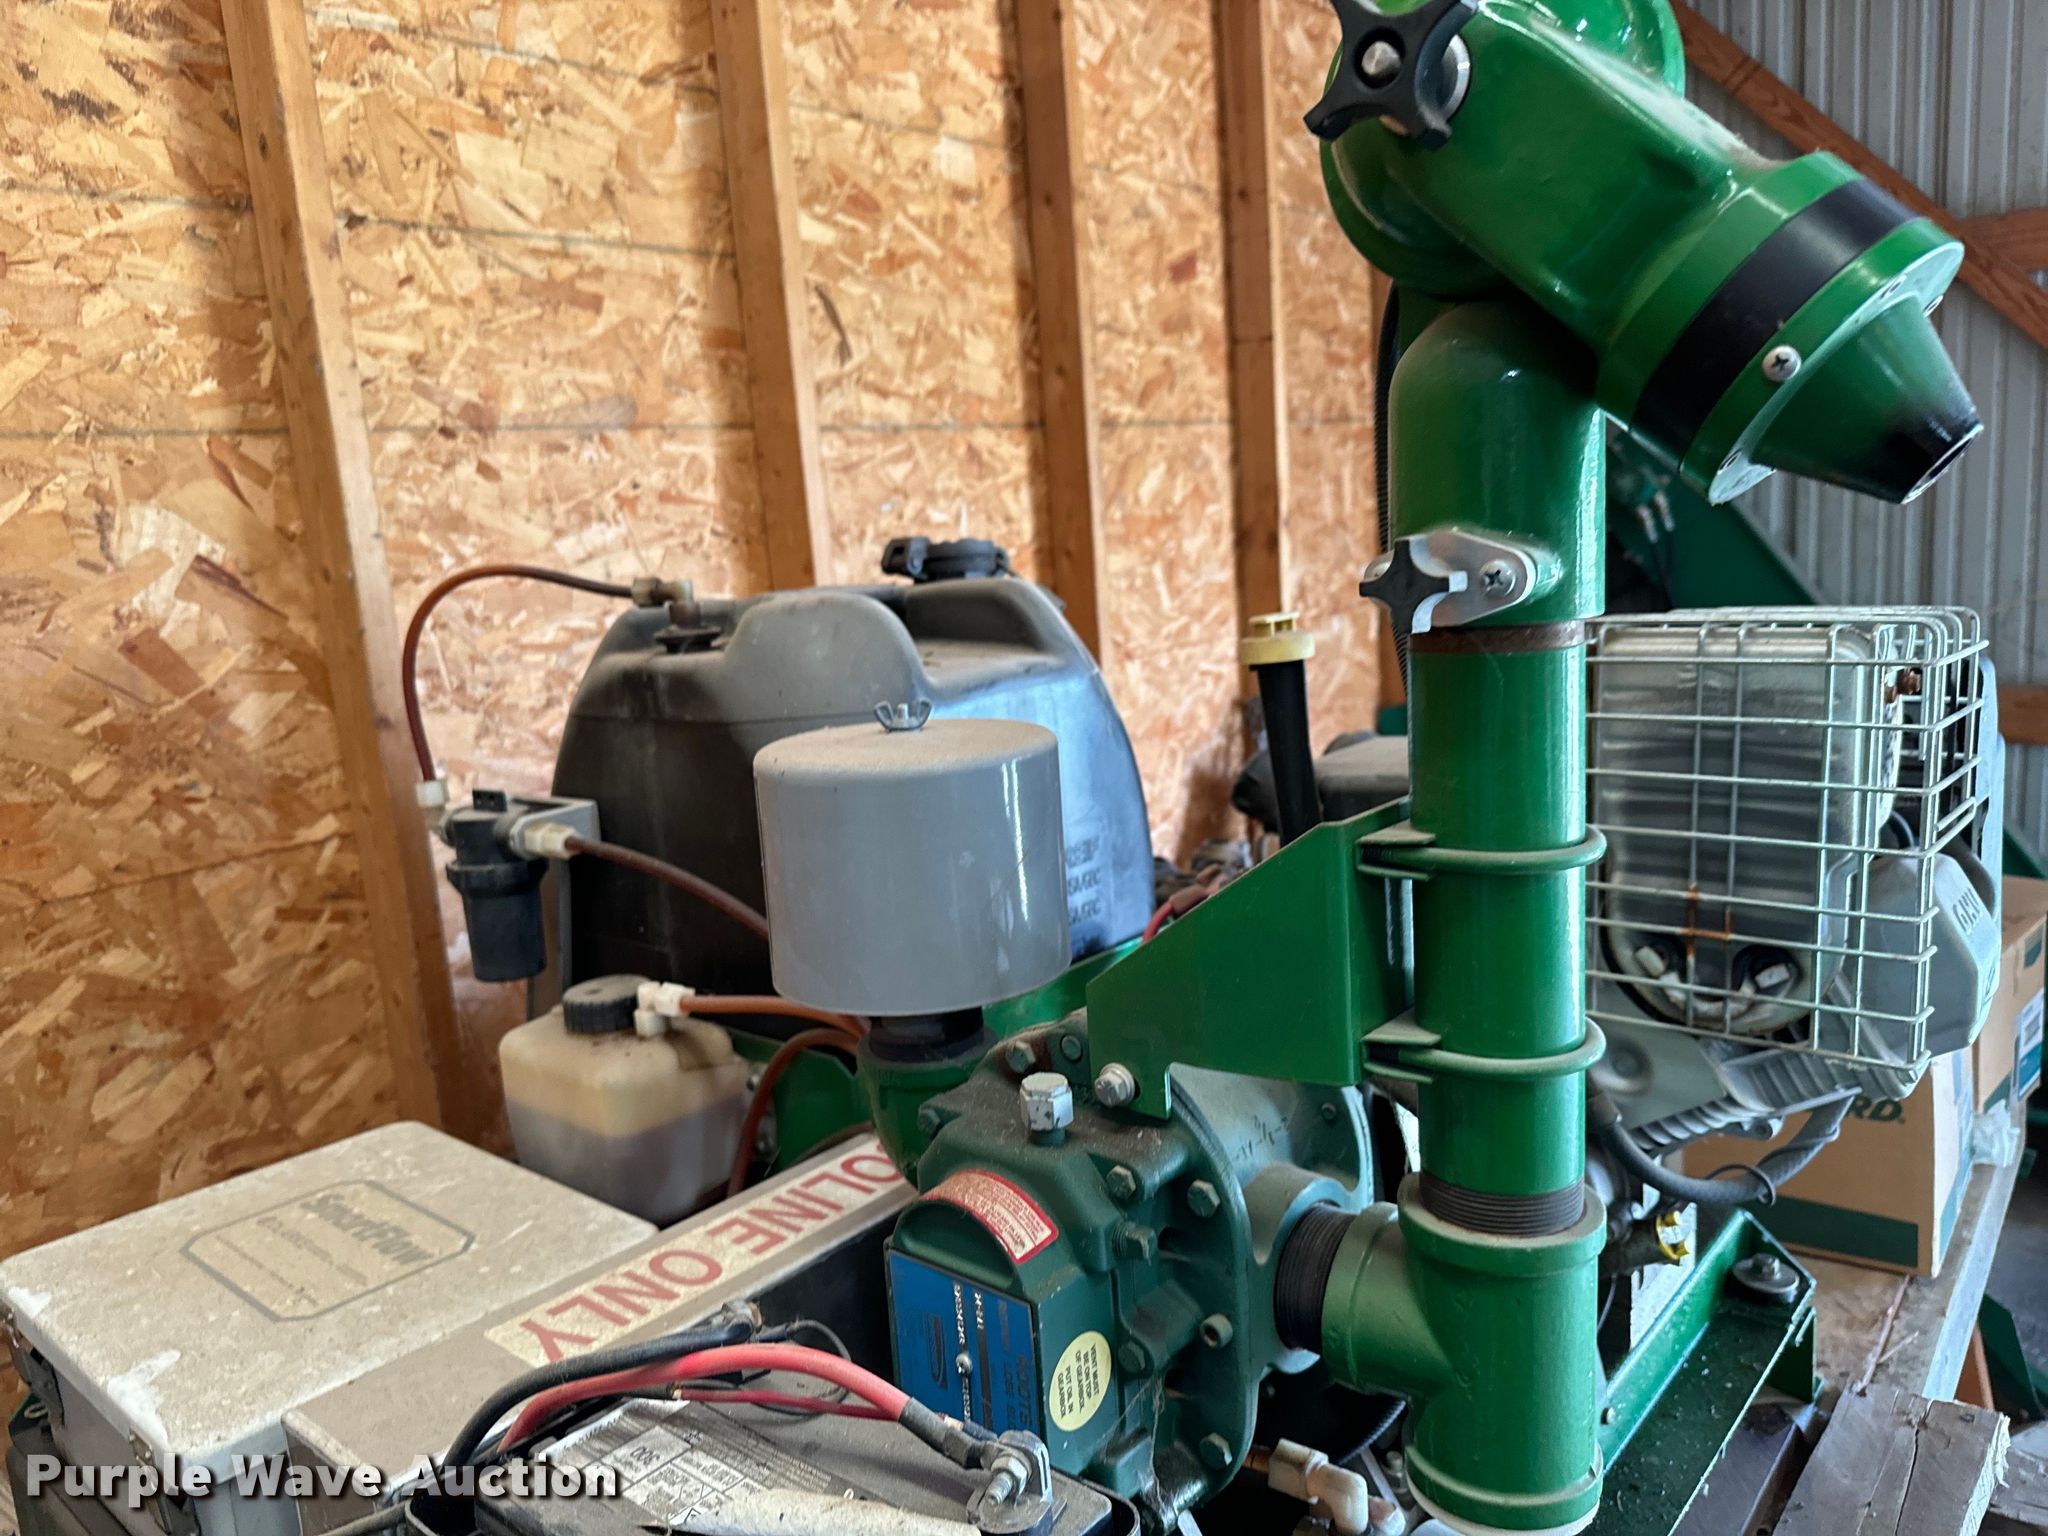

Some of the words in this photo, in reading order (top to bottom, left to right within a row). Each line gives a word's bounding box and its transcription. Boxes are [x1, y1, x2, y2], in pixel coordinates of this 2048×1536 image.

[706, 1142, 902, 1256] OLINE
[520, 1248, 723, 1363] ONLY
[1075, 1350, 1081, 1362] OF
[1083, 1351, 1089, 1365] BE
[1084, 1366, 1090, 1380] ON
[1057, 1372, 1066, 1419] GEARBOX
